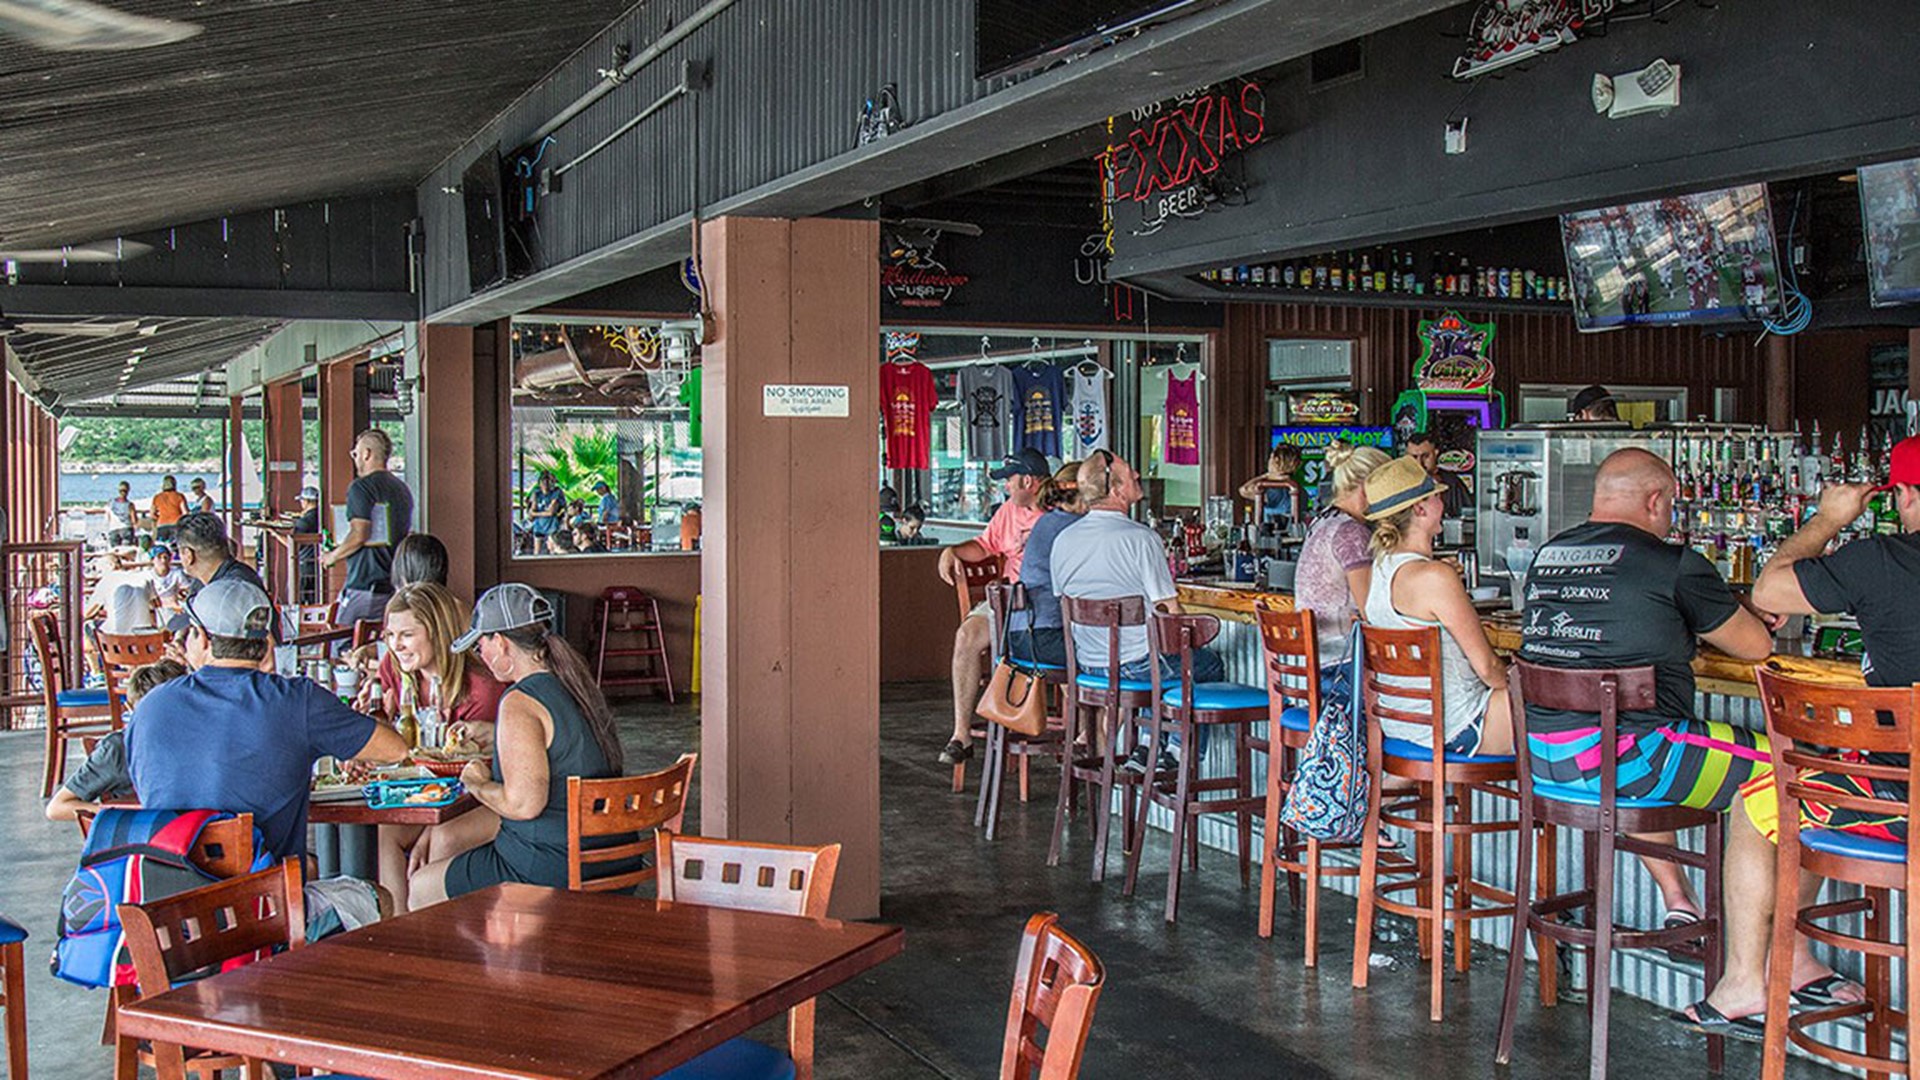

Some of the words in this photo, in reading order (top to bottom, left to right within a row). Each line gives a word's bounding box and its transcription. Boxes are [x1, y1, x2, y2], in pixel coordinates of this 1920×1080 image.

[1158, 186, 1198, 218] BEER
[905, 285, 936, 299] USA
[766, 387, 786, 398] NO
[788, 387, 846, 398] SMOKING
[1282, 431, 1338, 448] MONEY
[1570, 566, 1602, 575] PARK
